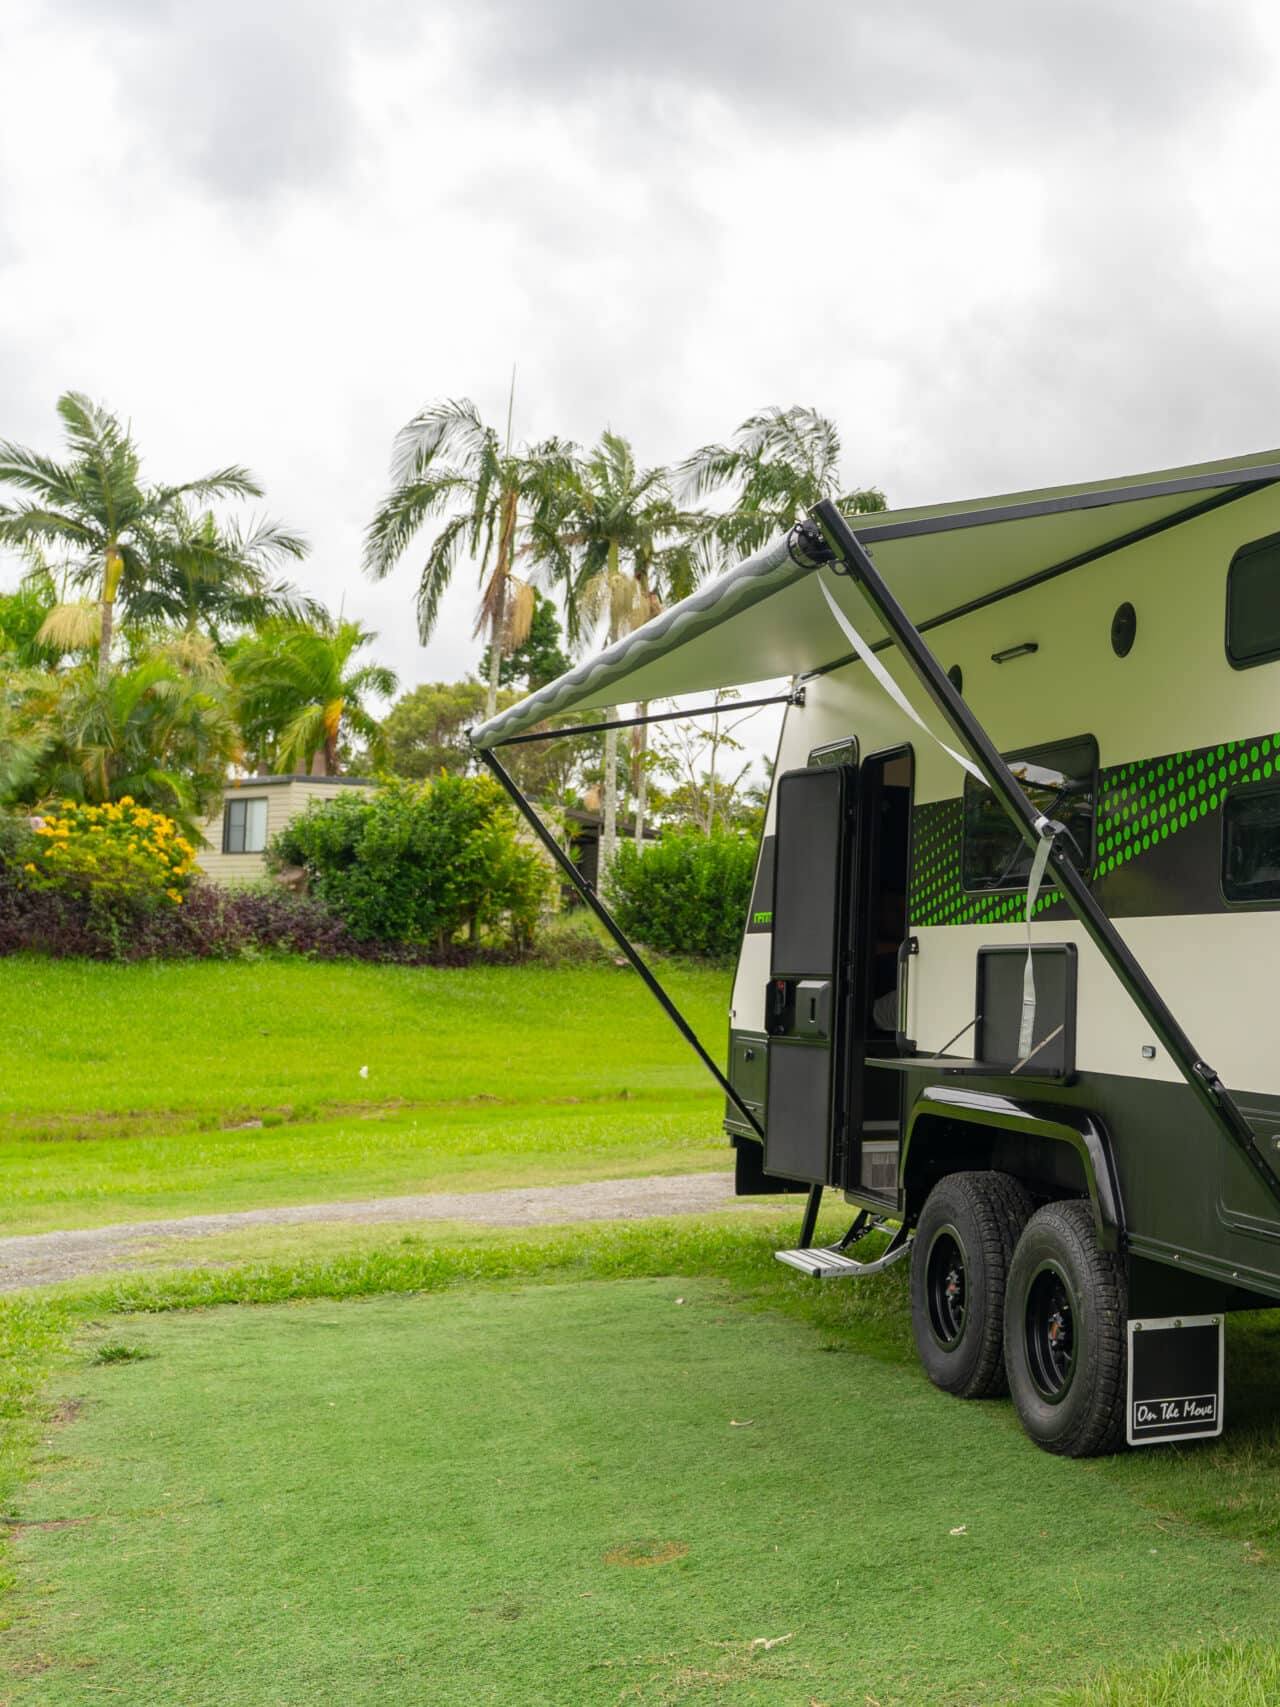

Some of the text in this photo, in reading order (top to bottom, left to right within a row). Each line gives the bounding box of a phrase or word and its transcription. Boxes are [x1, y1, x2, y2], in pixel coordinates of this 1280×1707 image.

[1137, 1401, 1213, 1422] On The Move
